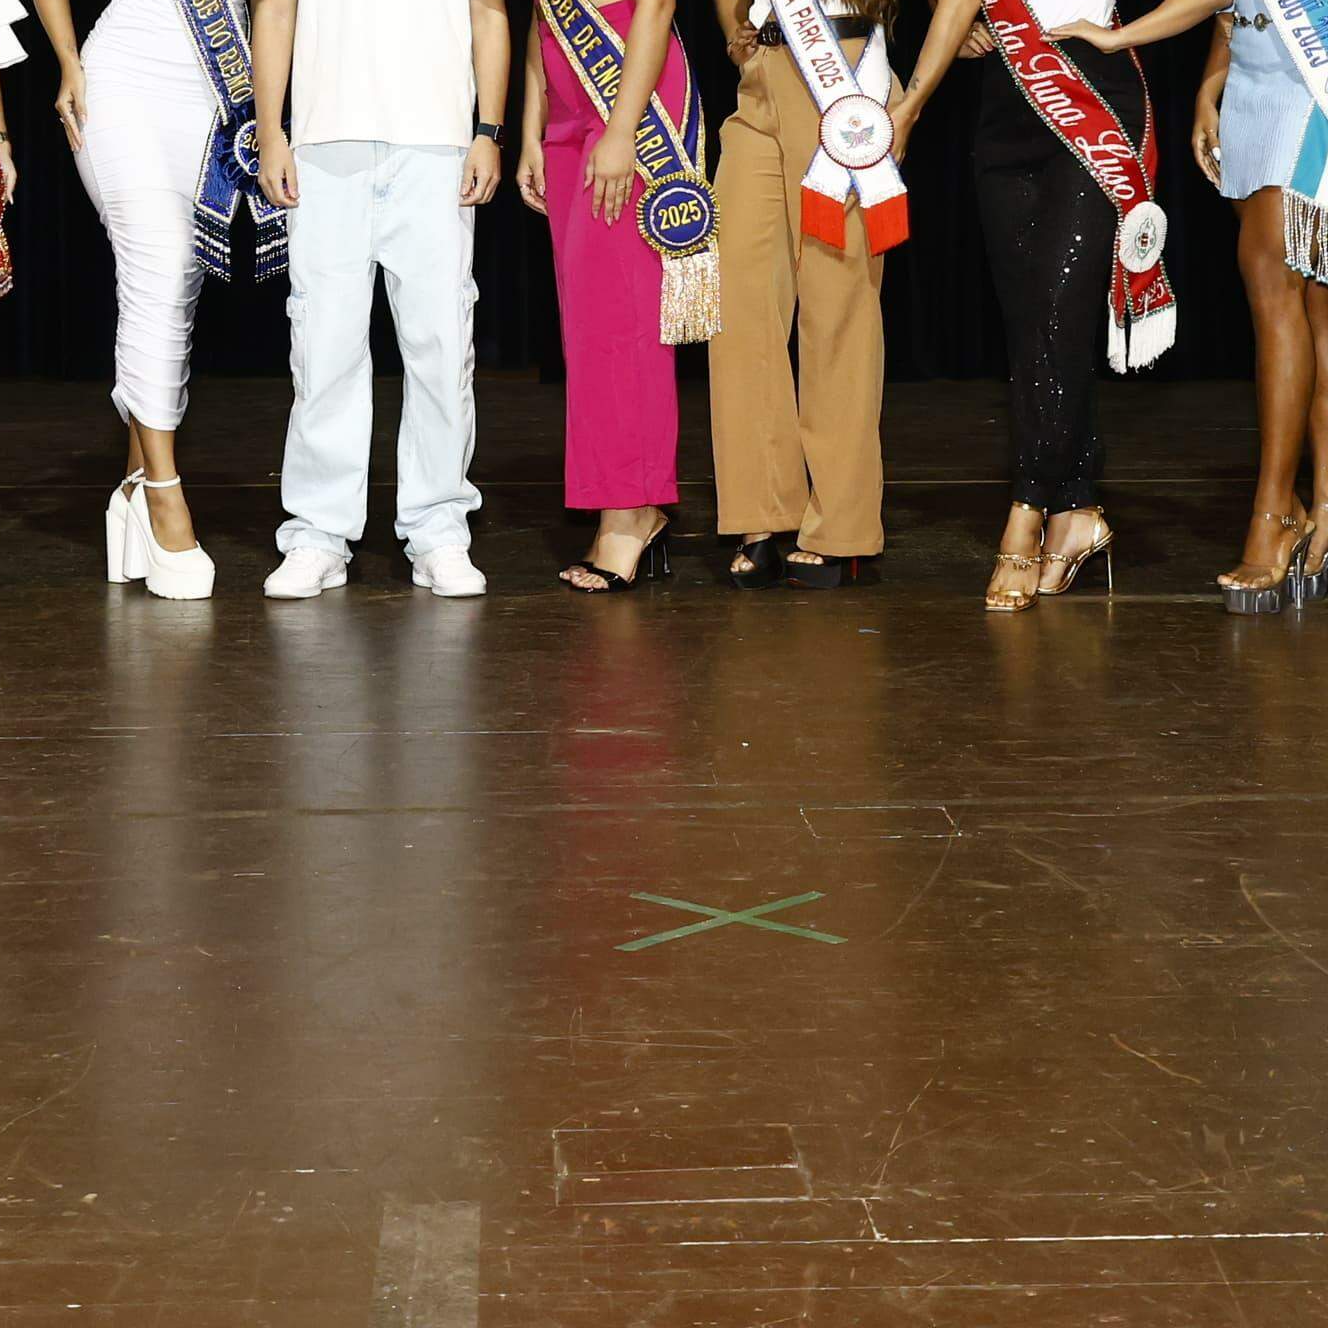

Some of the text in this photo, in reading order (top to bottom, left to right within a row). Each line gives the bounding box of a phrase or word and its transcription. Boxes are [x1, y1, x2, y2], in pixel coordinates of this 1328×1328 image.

[205, 18, 233, 48] DO
[571, 24, 603, 59] DE
[790, 6, 828, 52] PARK
[811, 52, 845, 89] 2025
[216, 49, 253, 104] REMO
[994, 20, 1030, 56] da
[1015, 52, 1088, 128] Tuna
[1075, 130, 1137, 201] Luso
[658, 199, 703, 231] 2025
